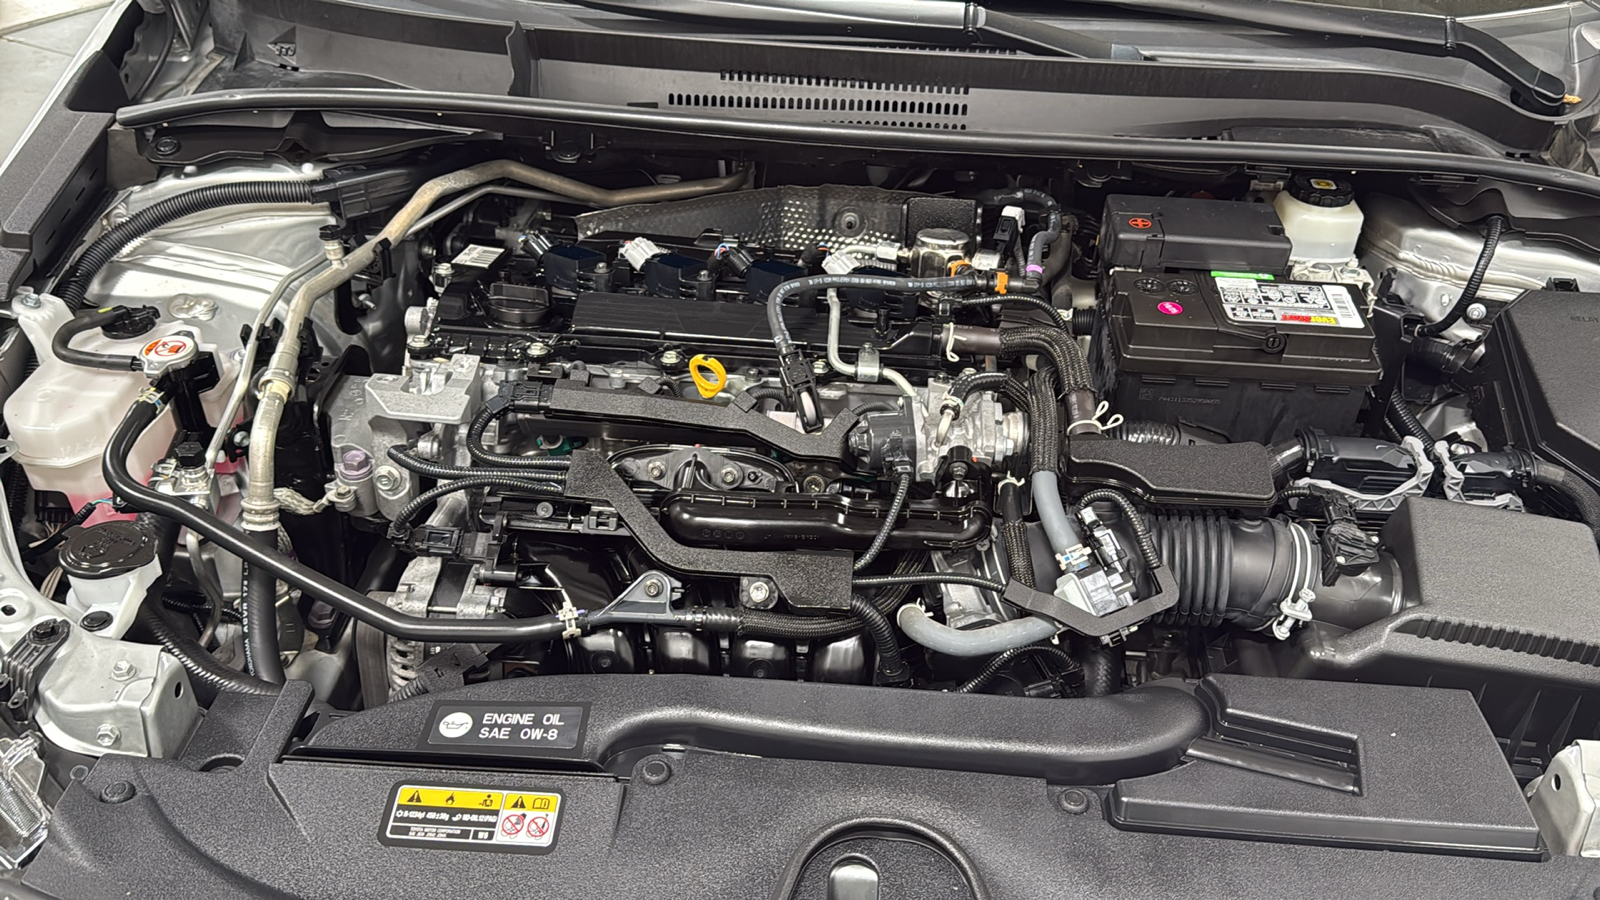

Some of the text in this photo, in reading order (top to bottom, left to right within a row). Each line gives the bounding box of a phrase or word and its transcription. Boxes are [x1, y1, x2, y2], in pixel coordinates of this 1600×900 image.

[482, 713, 565, 725] ENGINE OIL
[479, 727, 558, 740] SAE 0W-8
